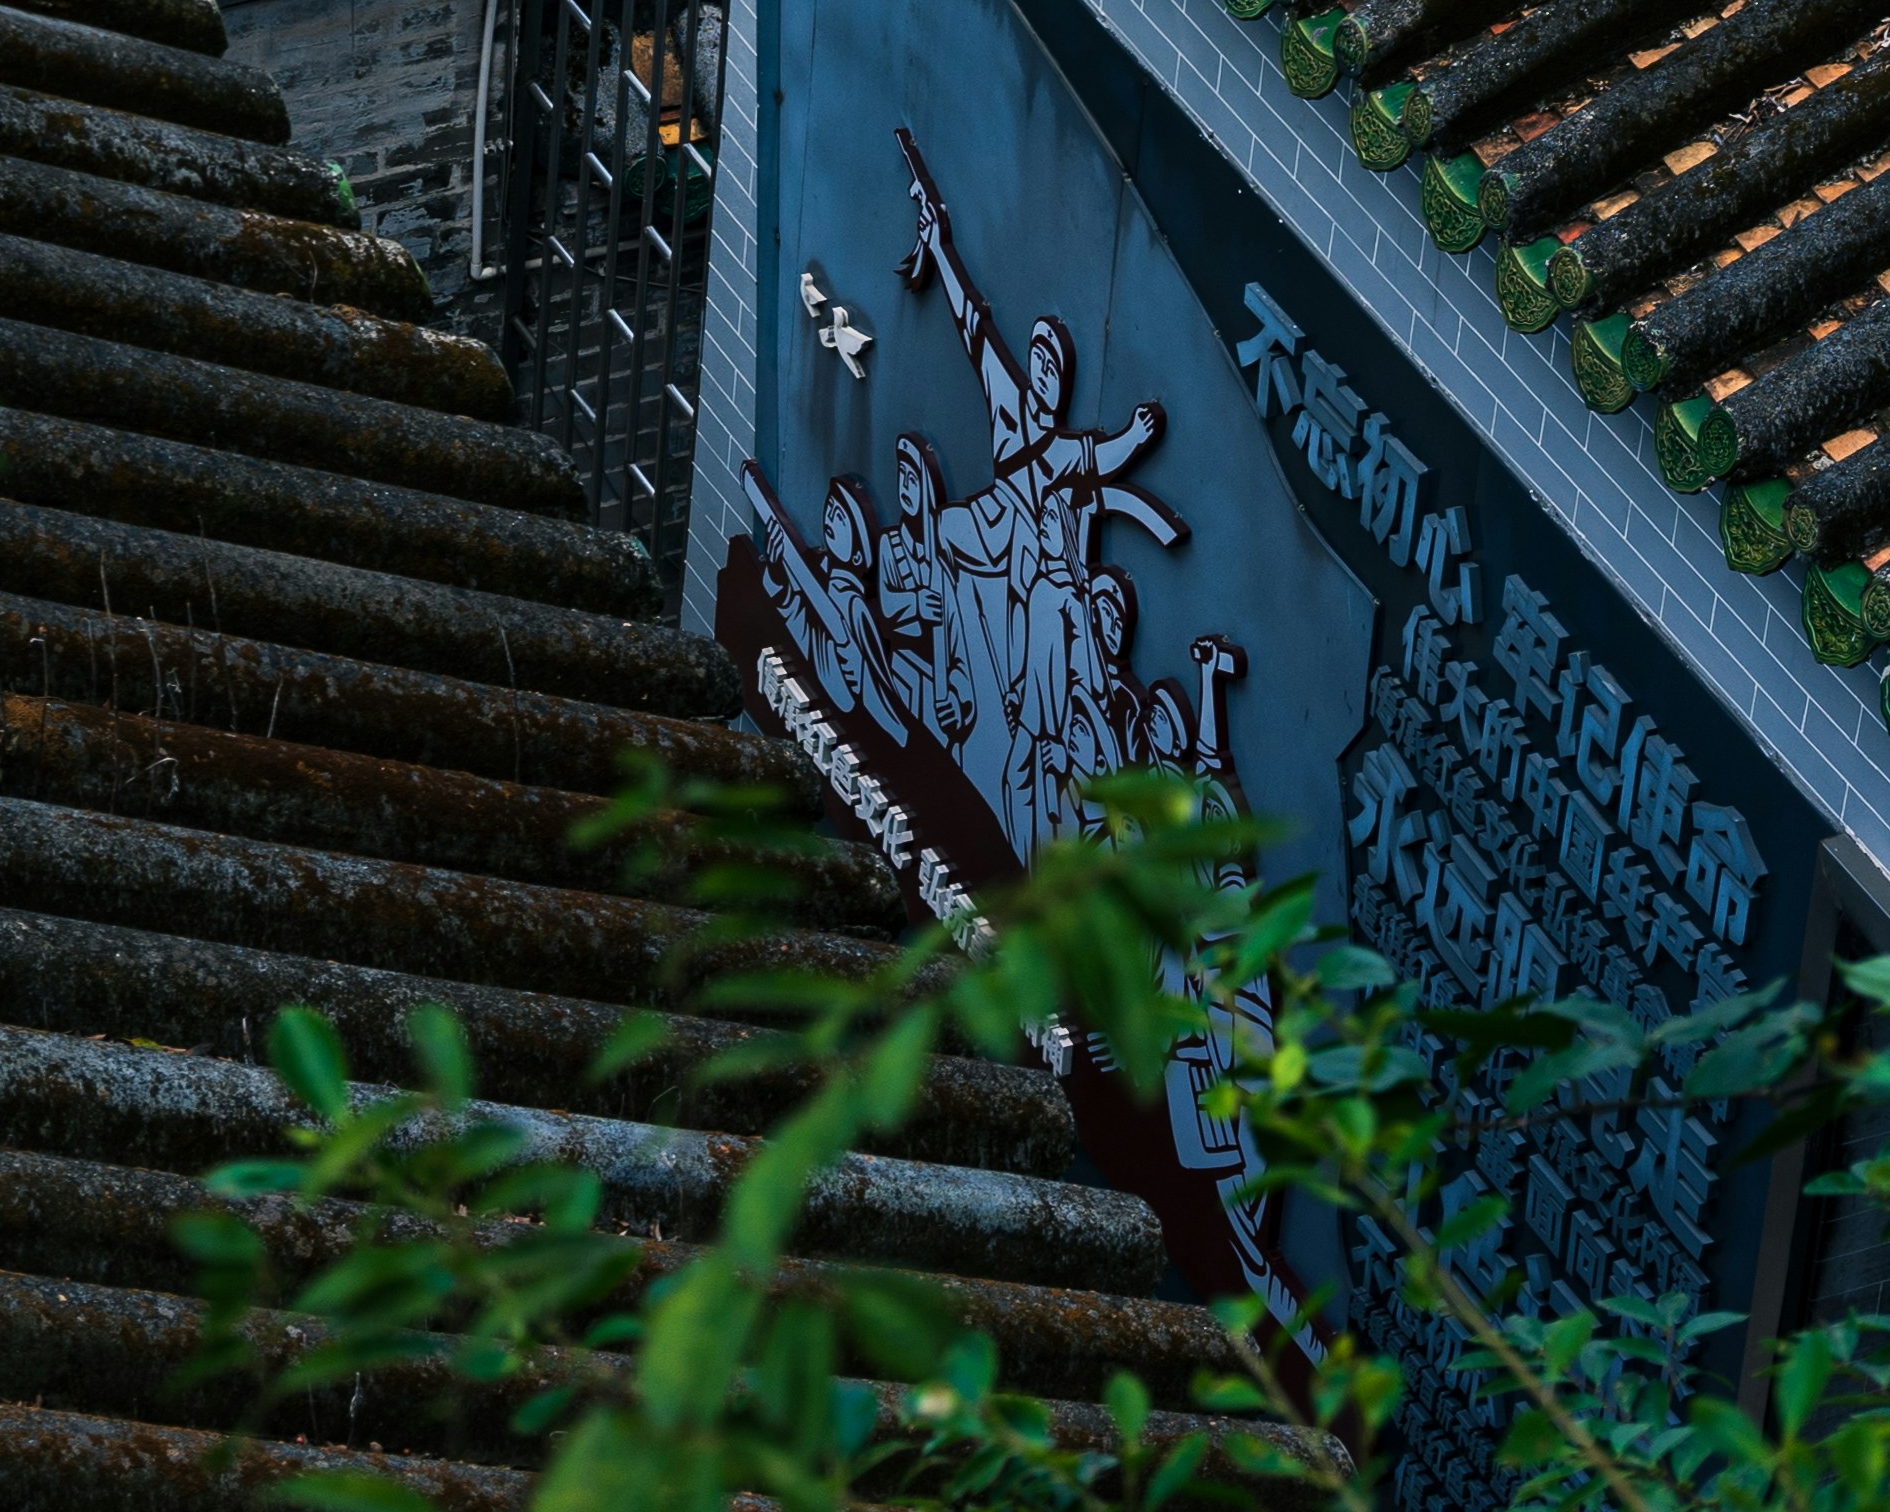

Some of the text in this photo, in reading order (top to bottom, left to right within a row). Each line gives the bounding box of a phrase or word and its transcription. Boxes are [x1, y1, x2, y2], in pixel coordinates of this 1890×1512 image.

[757, 646, 1073, 1077] 传承红色文化 弘扬革神
[1236, 281, 1485, 625] 不忘初心
[1492, 574, 1768, 945] 牢记使命
